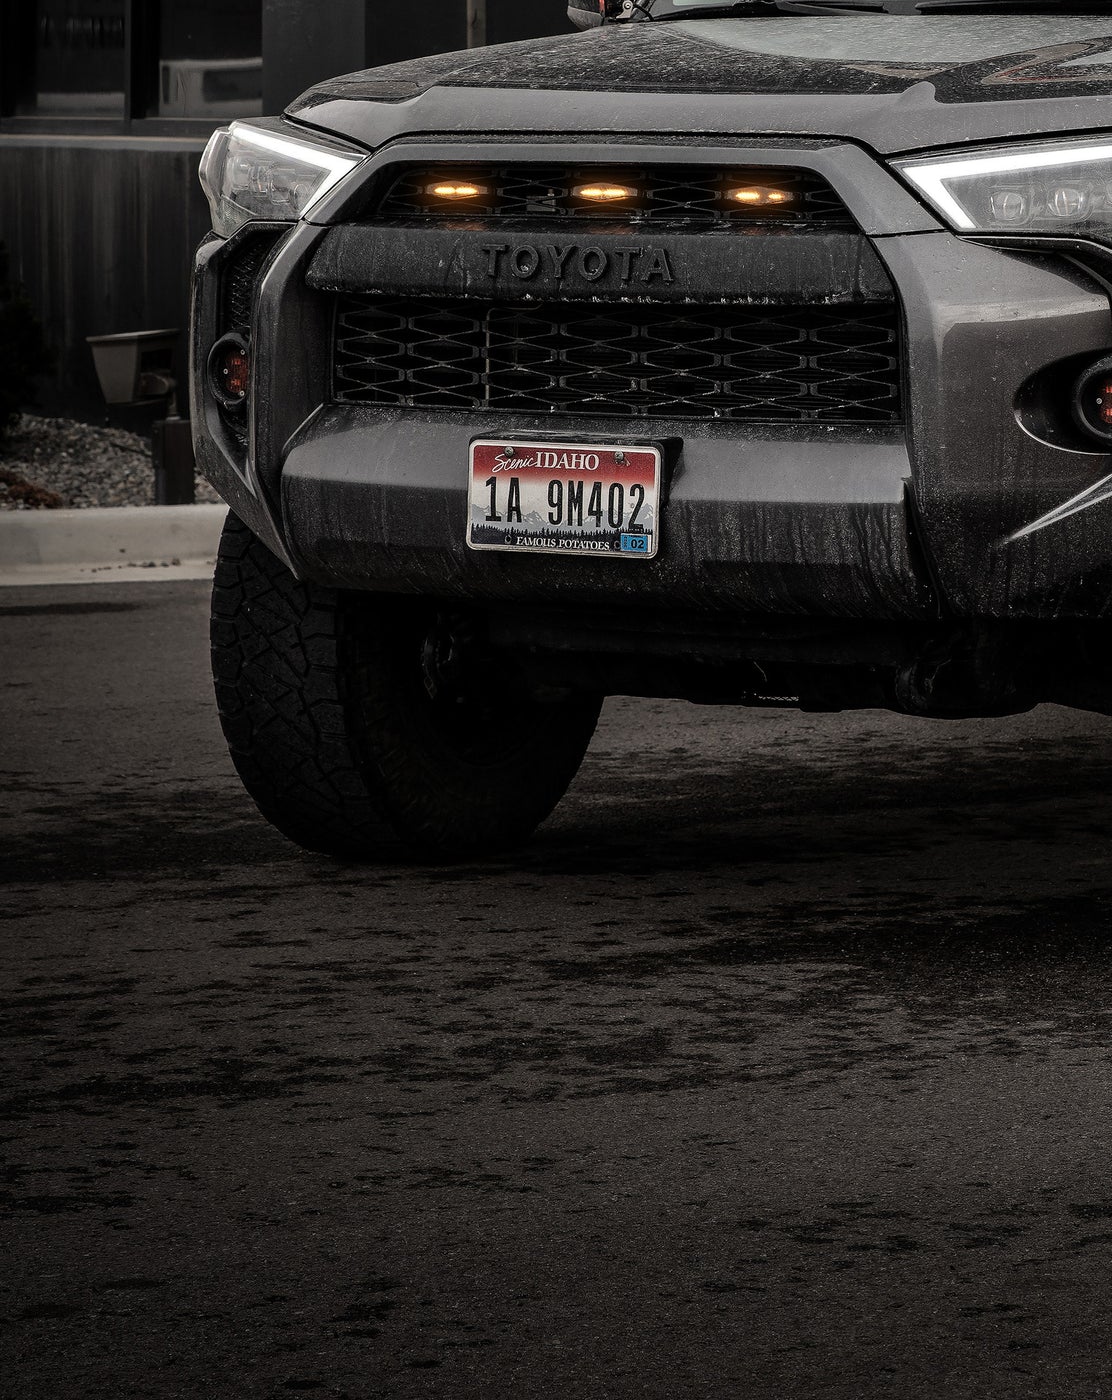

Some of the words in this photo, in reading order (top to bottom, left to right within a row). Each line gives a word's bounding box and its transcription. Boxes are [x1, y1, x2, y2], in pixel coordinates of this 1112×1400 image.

[482, 243, 674, 283] TOYOTA
[492, 453, 538, 473] Scenic
[535, 451, 600, 471] IDAHO
[485, 476, 523, 523] 1A
[547, 479, 646, 530] 9M402
[516, 536, 557, 548] FAMOUS
[558, 538, 610, 551] POTATOES
[631, 539, 644, 549] 02
